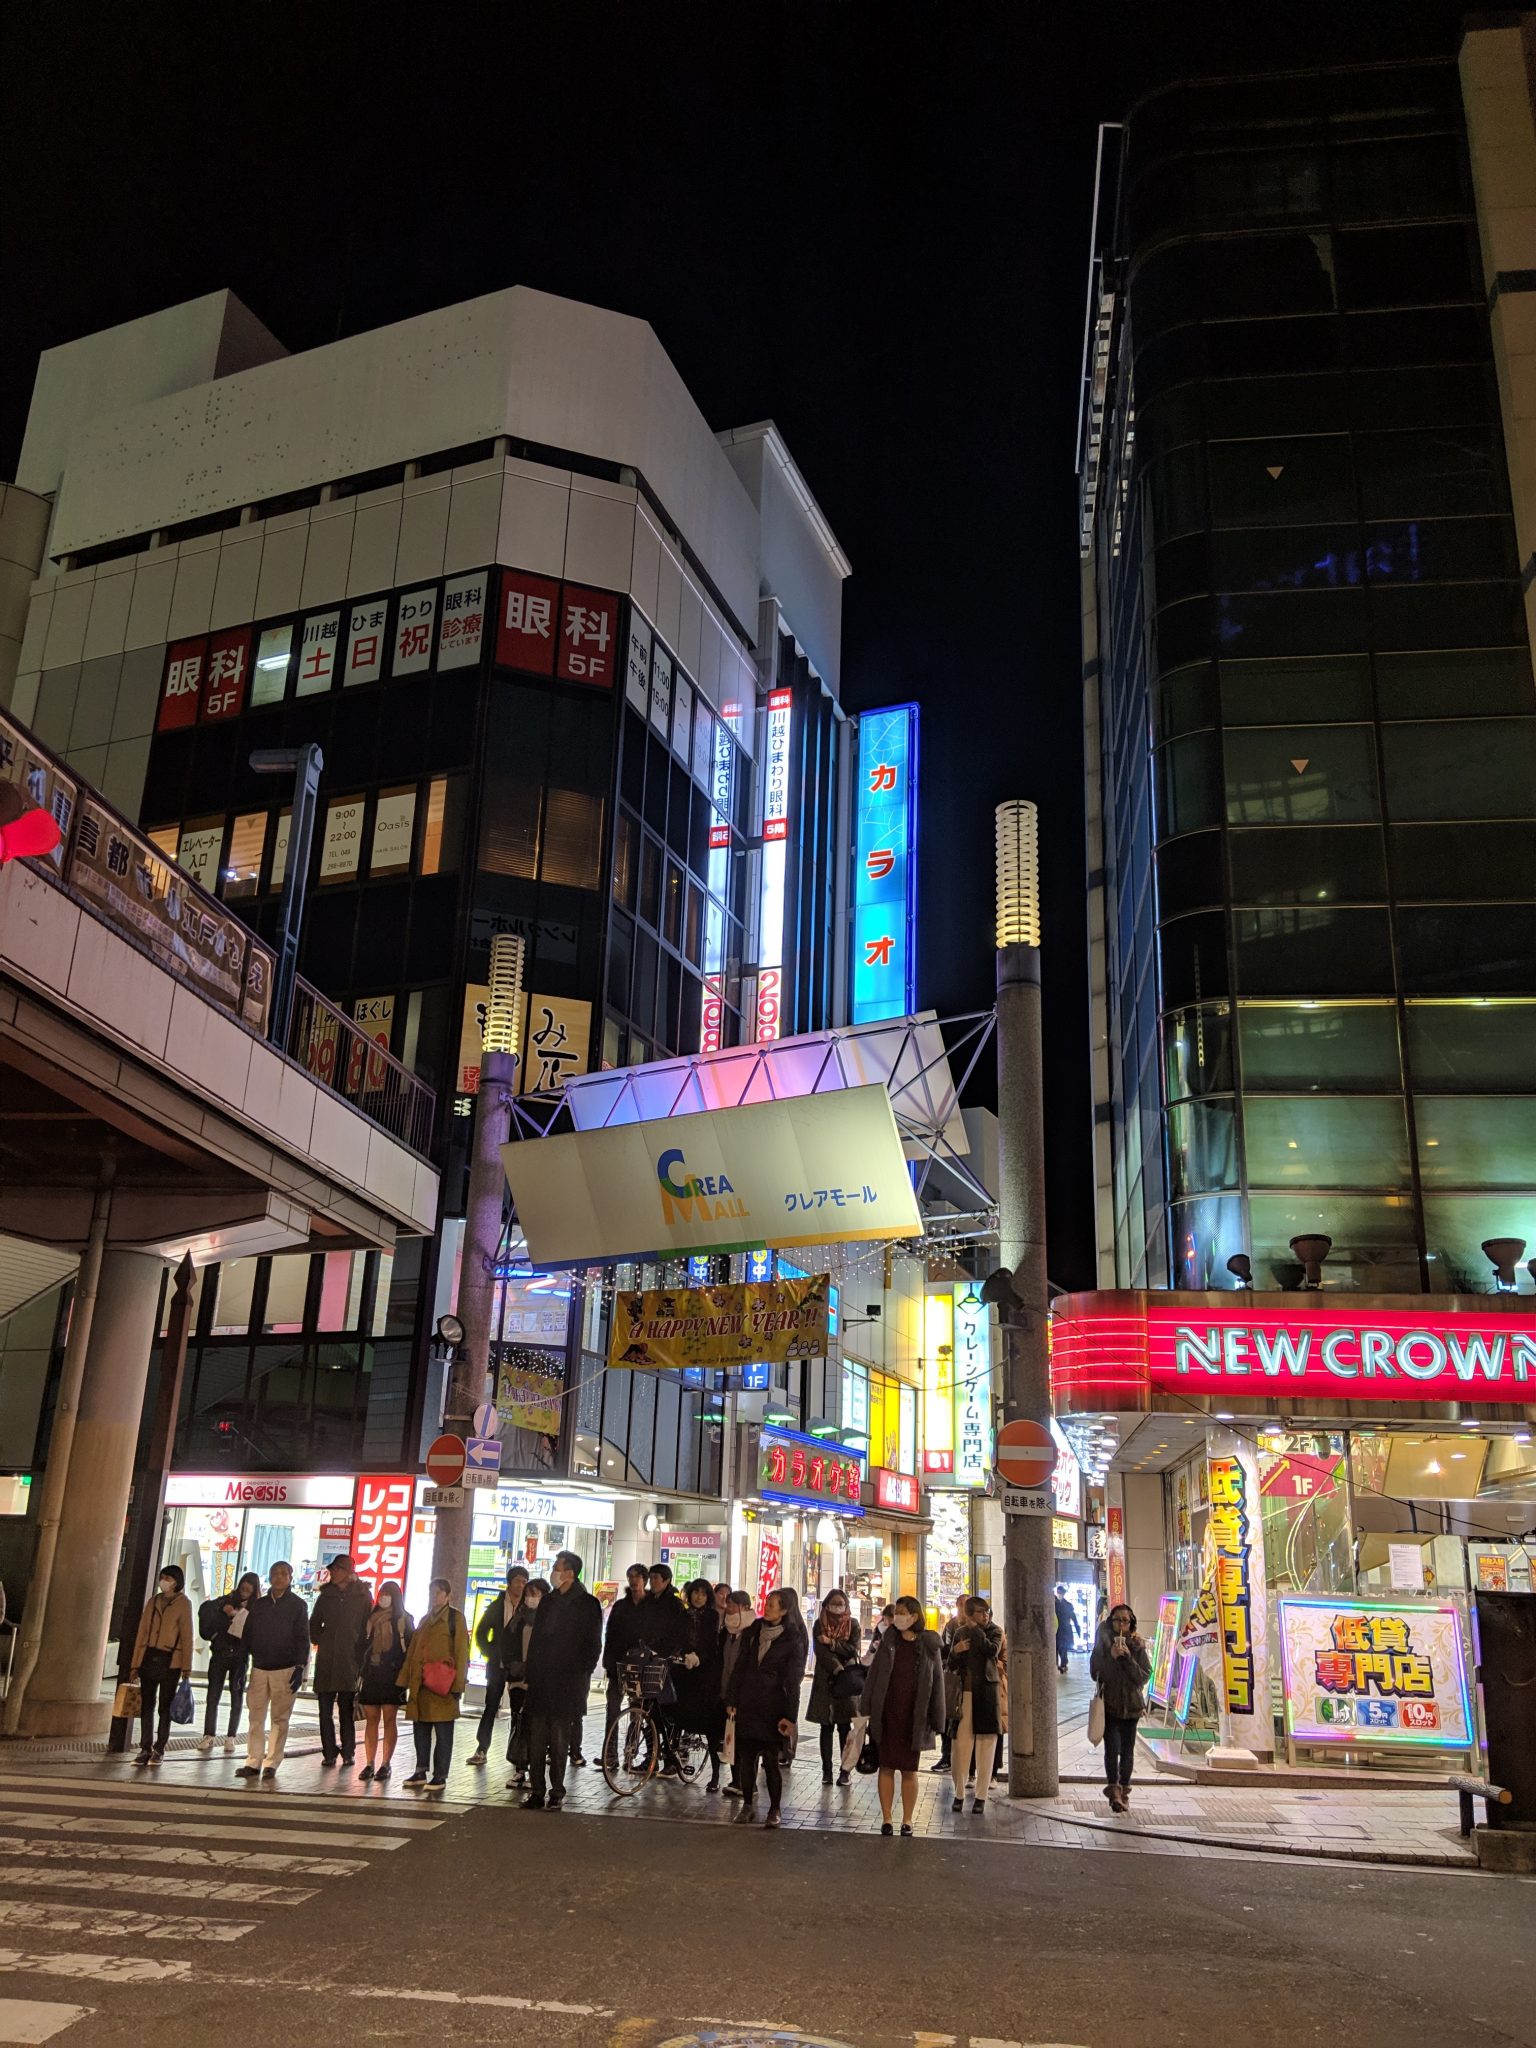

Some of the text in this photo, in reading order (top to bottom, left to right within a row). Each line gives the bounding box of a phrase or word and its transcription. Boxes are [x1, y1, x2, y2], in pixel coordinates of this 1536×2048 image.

[442, 613, 482, 640] 診療
[505, 590, 611, 652] 眼科
[440, 635, 481, 650] しています
[631, 634, 648, 665] 午前
[165, 646, 244, 697] 眼科
[568, 654, 606, 679] 5F
[629, 659, 646, 692] 午後
[207, 690, 237, 715] 5F
[769, 711, 786, 818] 川越ひまわり眼科
[335, 808, 356, 820] 9:00
[377, 819, 410, 832] Oasis
[182, 835, 221, 852] エレベーター
[330, 830, 357, 842] 22:00
[189, 853, 208, 869] 入口
[657, 1148, 734, 1199] CREA
[660, 1173, 750, 1225] MALL
[784, 1185, 878, 1212] クレアモール
[629, 1320, 644, 1340] A
[647, 1317, 703, 1339] HAPPY
[706, 1314, 748, 1338] NEW
[752, 1309, 801, 1333] YEAR
[1175, 1326, 1313, 1376] NEW
[748, 1375, 764, 1388] 1F
[963, 1321, 983, 1469] クレーンゲーム専門店
[928, 1451, 950, 1469] B1
[225, 1481, 287, 1502] Measis
[1292, 1475, 1313, 1495] 1F
[426, 1492, 460, 1504] 自転車を除く
[501, 1495, 557, 1515] 中央コンタクト
[1004, 1495, 1052, 1511] 自転車を除く
[667, 1536, 690, 1545] MAYA
[1093, 1530, 1104, 1558] うどん
[1332, 1616, 1410, 1653] 低貸
[1316, 1651, 1434, 1695] 専門店
[1369, 1701, 1389, 1719] 5円
[1406, 1703, 1434, 1720] 10円
